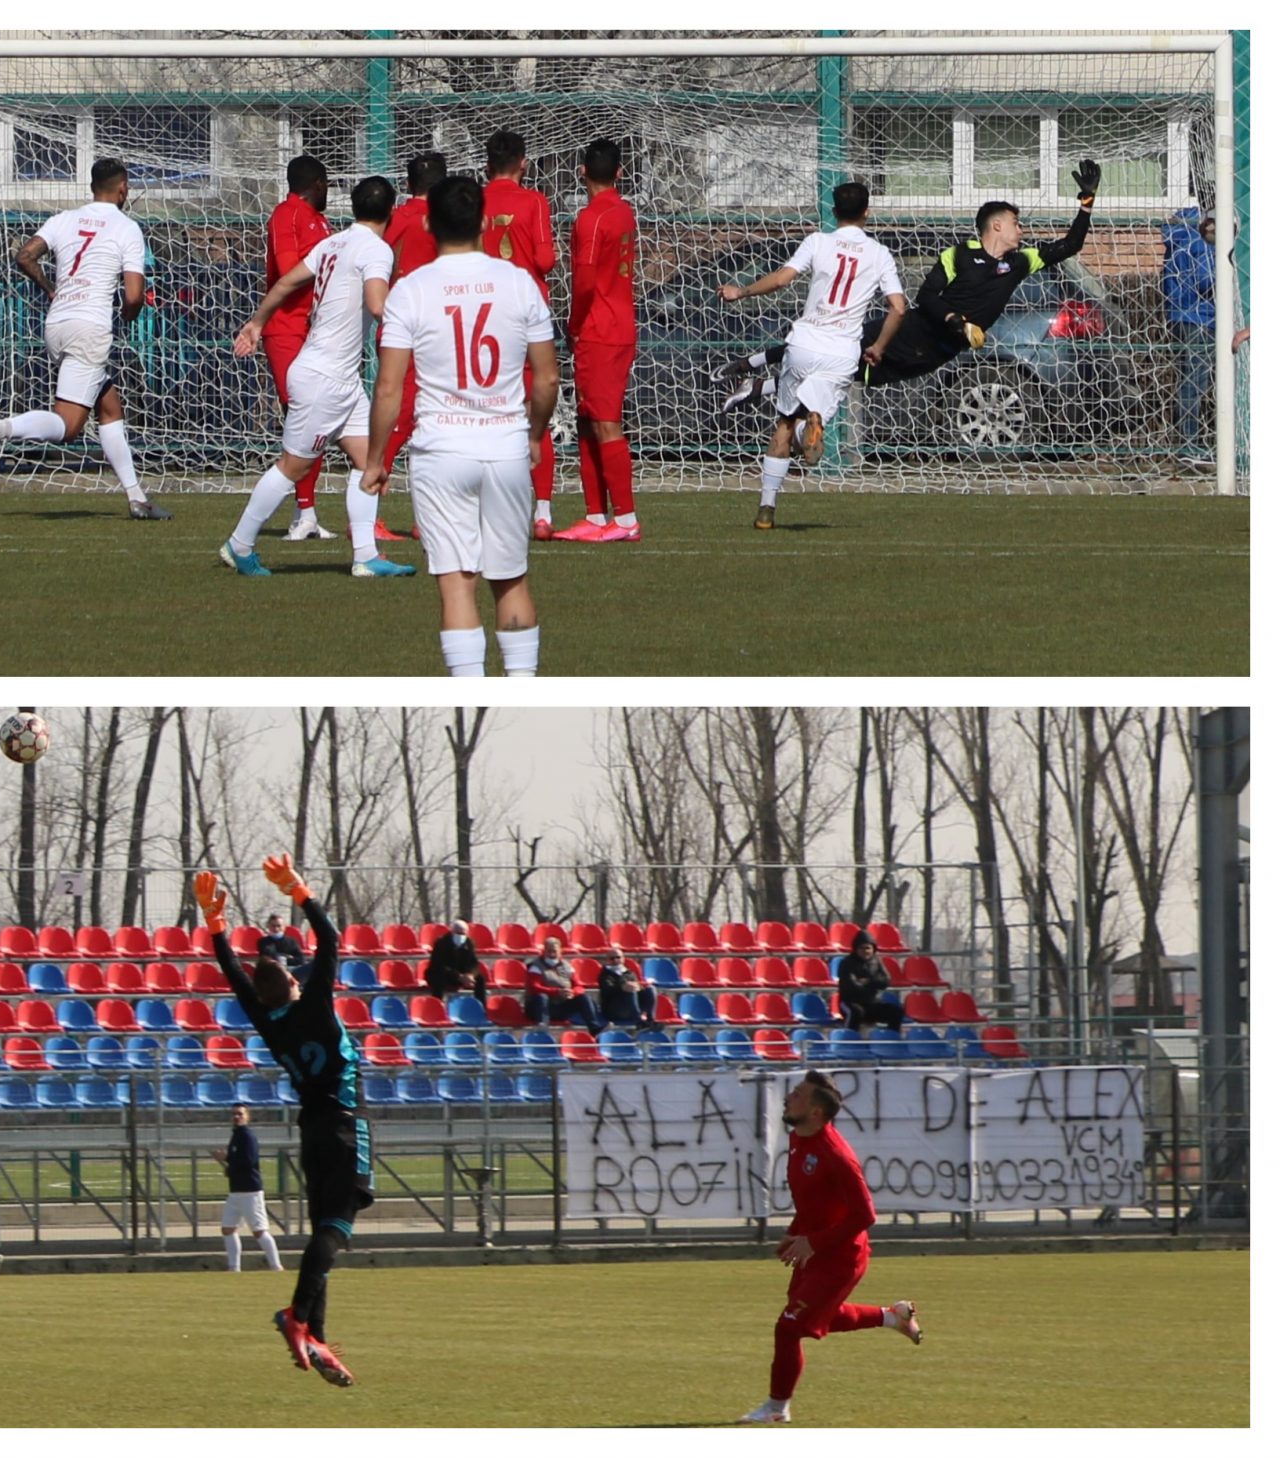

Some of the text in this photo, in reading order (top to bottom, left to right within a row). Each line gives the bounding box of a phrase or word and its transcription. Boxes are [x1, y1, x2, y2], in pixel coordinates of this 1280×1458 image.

[68, 229, 97, 277] 7
[443, 282, 495, 296] SPORT CLUB
[828, 253, 859, 308] 11
[444, 302, 501, 391] 16
[437, 413, 475, 427] GALAXY
[65, 880, 74, 895] 2
[922, 1073, 991, 1133] DE
[1016, 1067, 1145, 1125] ALEX
[1060, 1125, 1125, 1157] VCM
